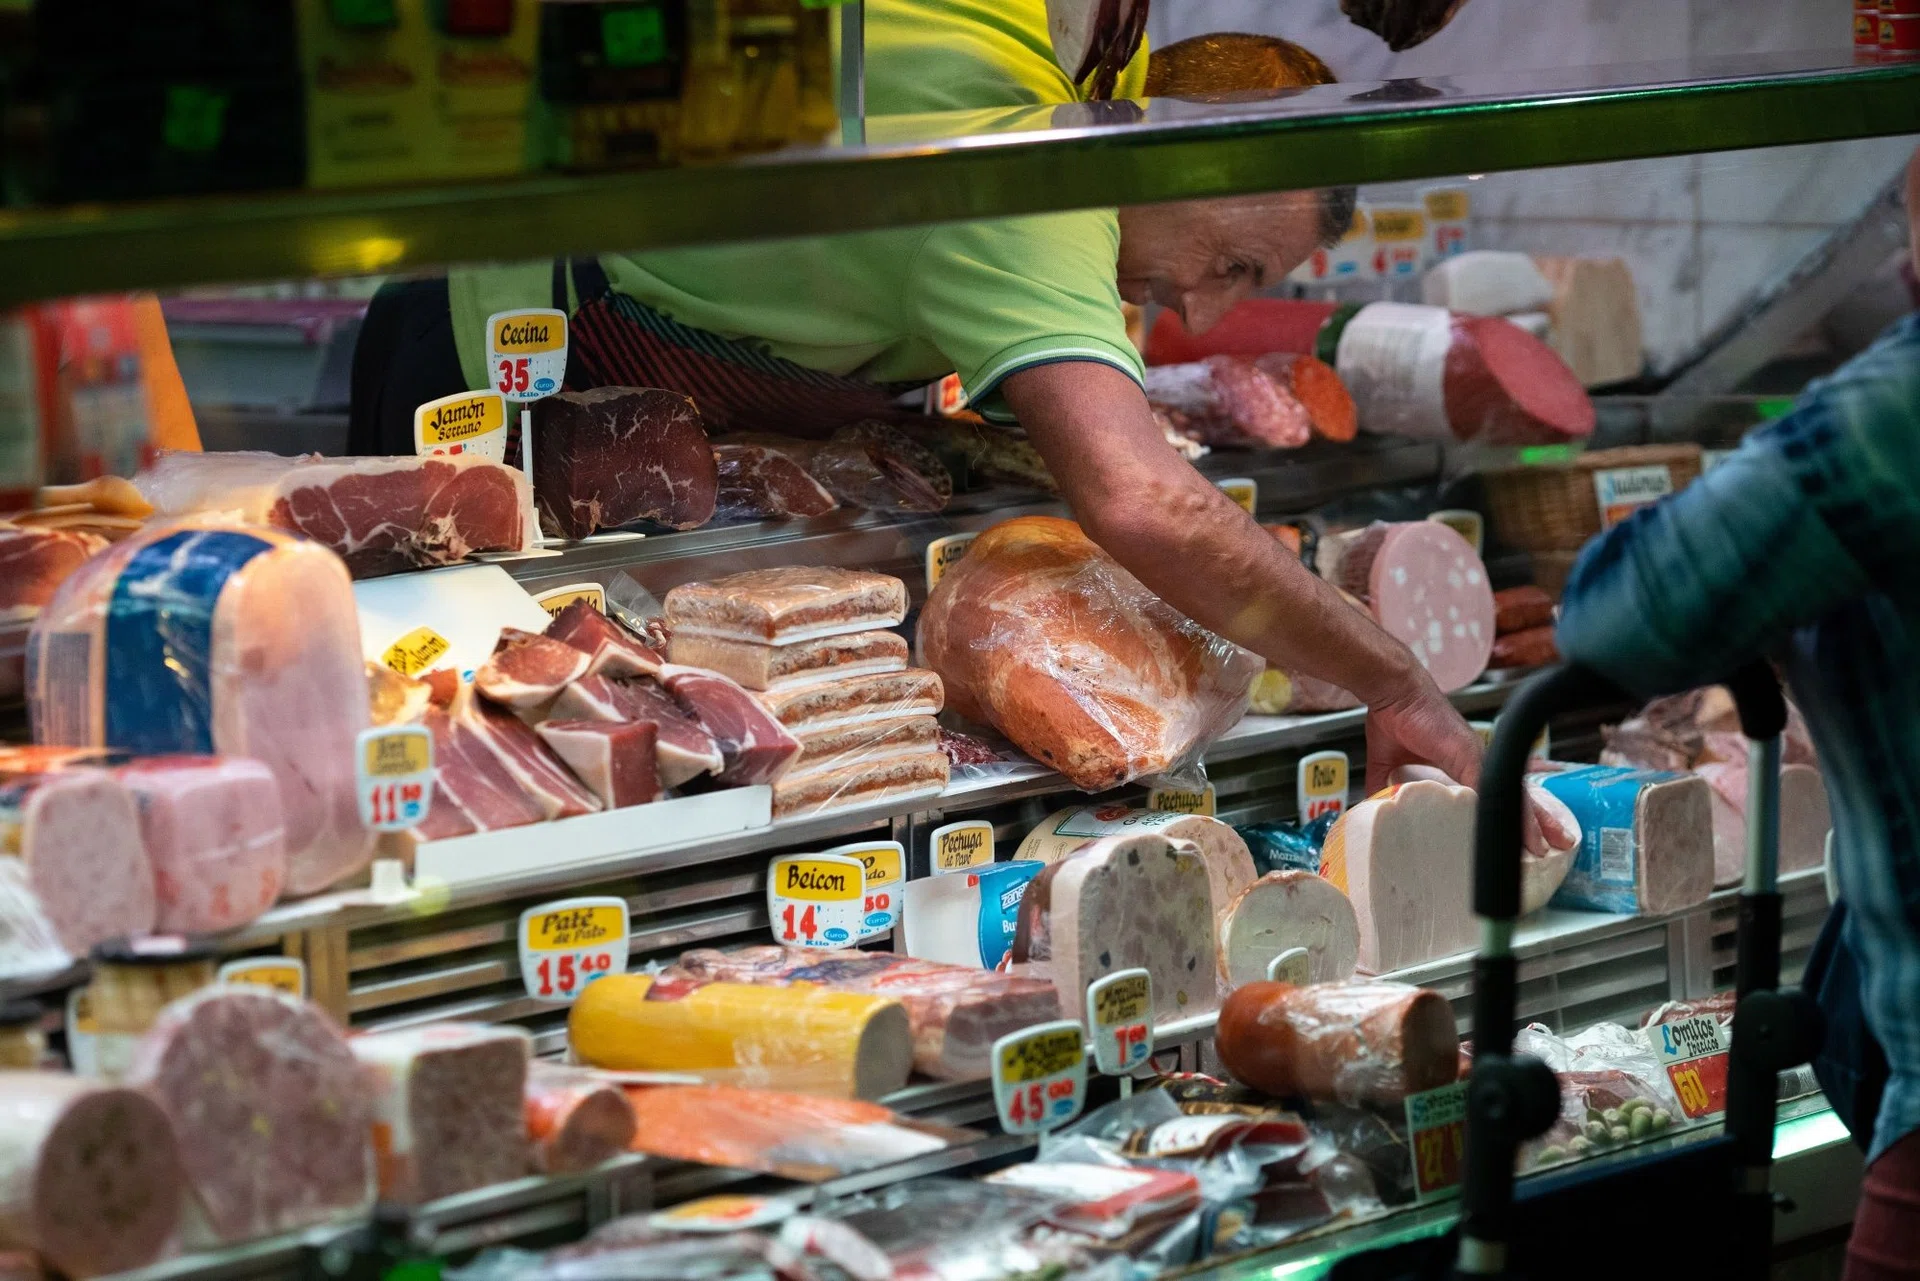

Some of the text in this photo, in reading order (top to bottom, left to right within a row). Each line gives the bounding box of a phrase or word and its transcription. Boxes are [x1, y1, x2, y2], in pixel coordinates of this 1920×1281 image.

[500, 322, 549, 346] Cecina
[430, 400, 485, 430] Jamón
[438, 421, 482, 441] Serrano
[942, 831, 983, 856] Pechuga
[787, 865, 845, 891] Beicon
[1662, 1018, 1715, 1055] Lomitos
